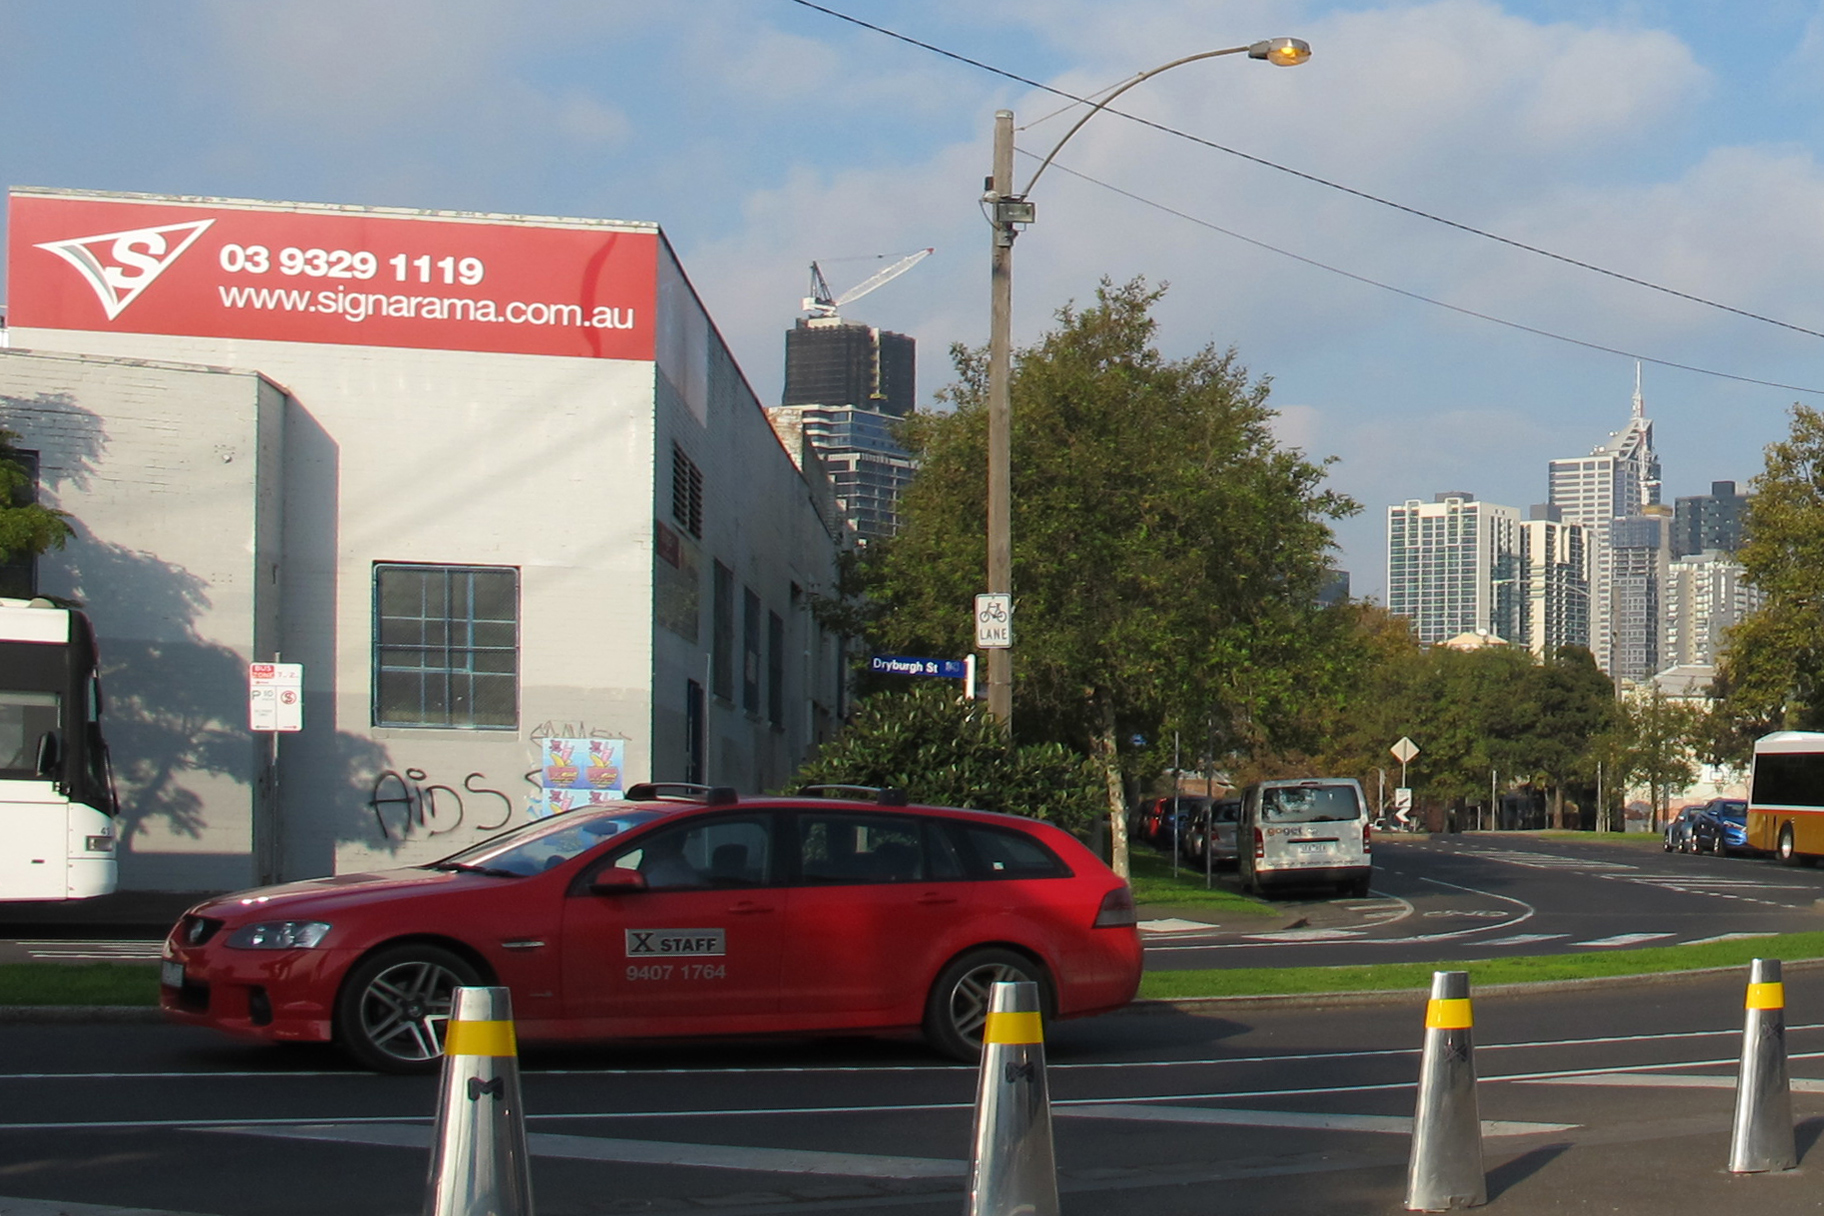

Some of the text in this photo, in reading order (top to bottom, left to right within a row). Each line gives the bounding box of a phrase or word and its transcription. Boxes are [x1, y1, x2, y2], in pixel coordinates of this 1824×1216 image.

[219, 243, 485, 286] 03 9329 1119
[218, 285, 635, 330] www.signarama.com.au
[979, 628, 1007, 640] LANE
[873, 657, 923, 674] Dryburgh
[926, 661, 939, 674] St
[252, 689, 261, 700] P
[631, 932, 717, 953] X STAFF
[626, 964, 726, 981] 9407 1764
